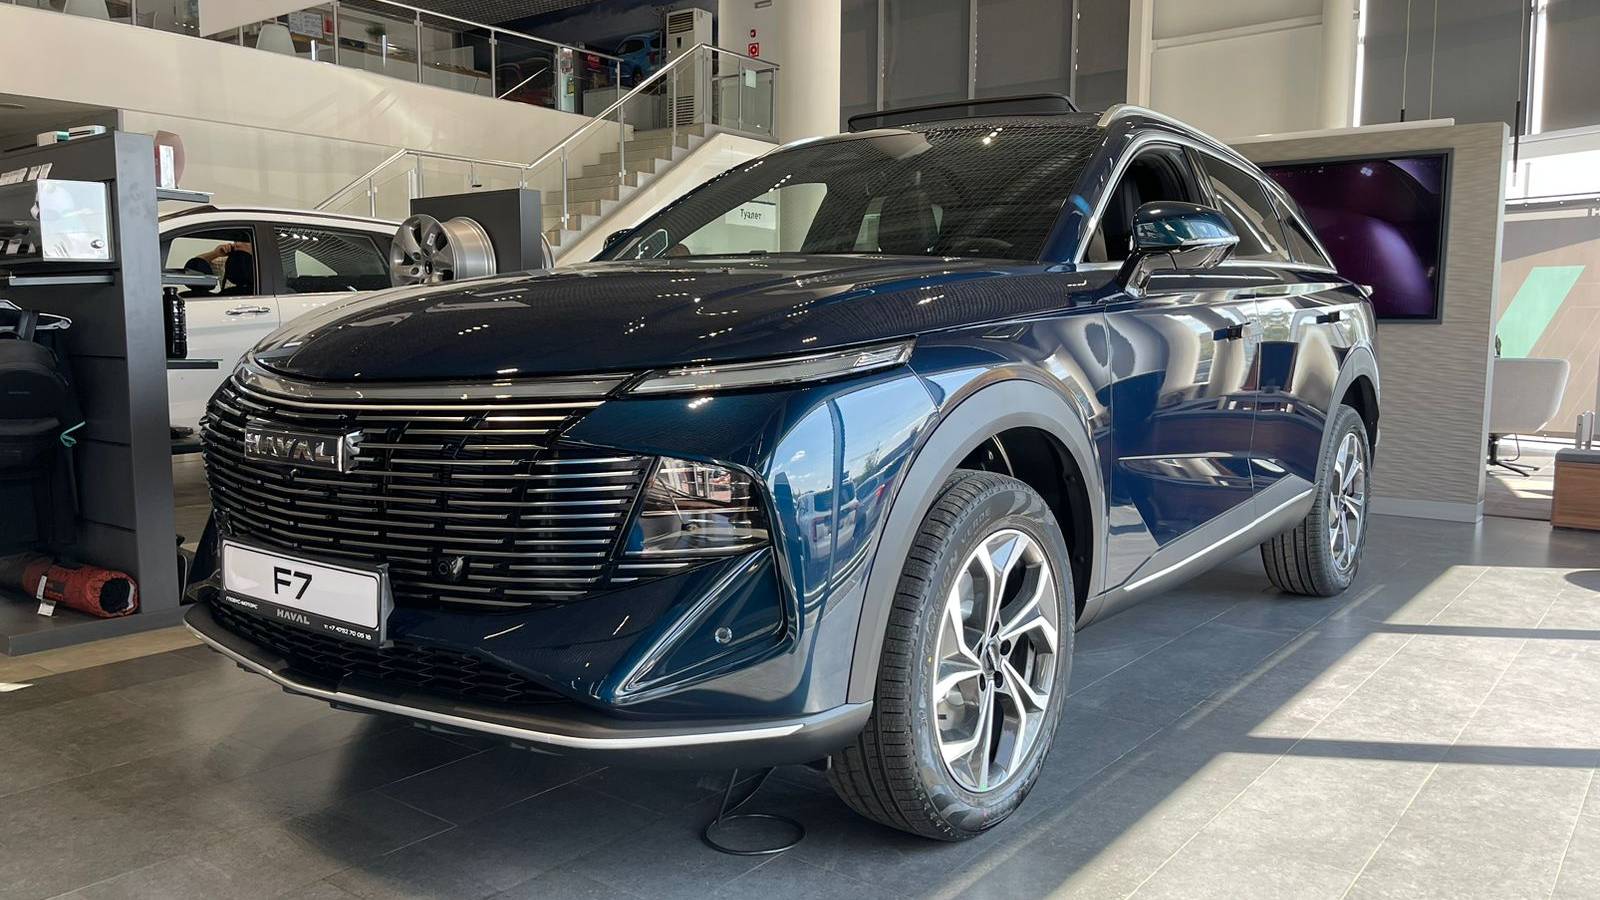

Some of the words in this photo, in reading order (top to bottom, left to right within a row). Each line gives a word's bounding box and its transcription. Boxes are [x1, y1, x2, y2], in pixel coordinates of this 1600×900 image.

[740, 208, 762, 220] Туалет
[246, 432, 336, 465] HAVAL
[273, 565, 313, 600] F7
[276, 608, 310, 625] HAVAL
